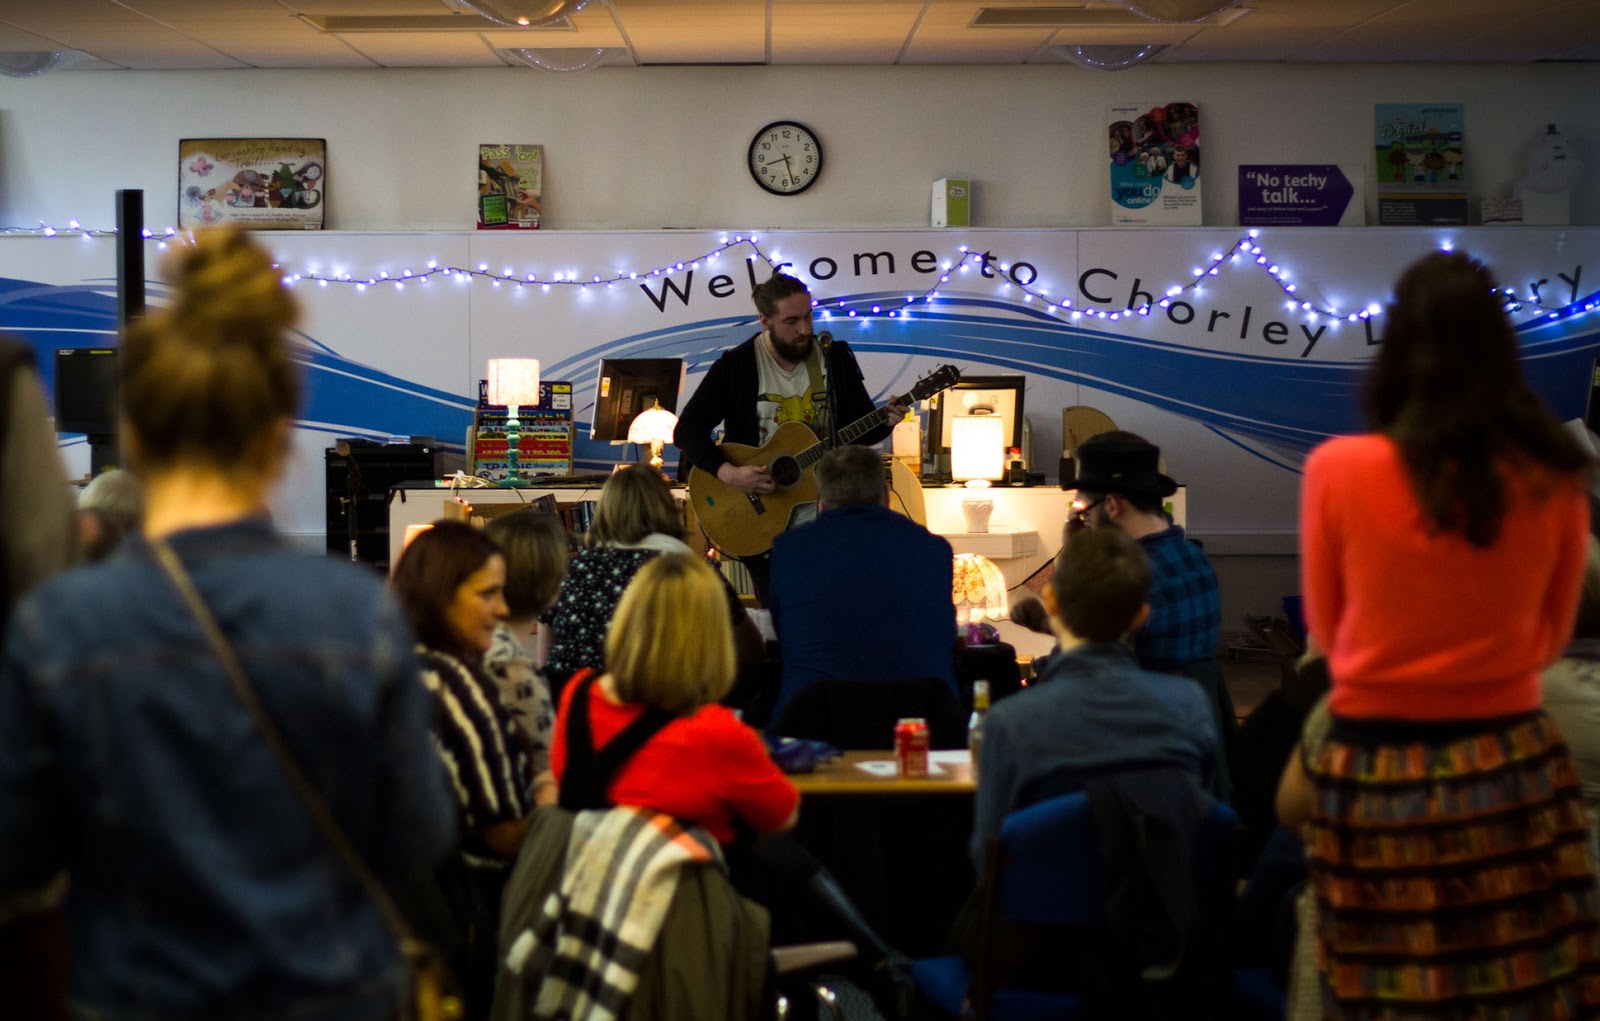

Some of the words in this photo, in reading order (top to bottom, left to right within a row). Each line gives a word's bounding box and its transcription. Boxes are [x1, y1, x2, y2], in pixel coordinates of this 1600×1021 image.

[781, 130, 791, 139] 12
[761, 142, 771, 151] 10
[804, 143, 810, 151] 2
[481, 146, 510, 160] Pass
[758, 154, 765, 162] 9
[806, 155, 812, 163] 3
[761, 166, 768, 175] 8
[770, 175, 776, 183] 7
[782, 179, 788, 187] 6
[794, 176, 800, 184] 5
[1284, 173, 1327, 191] techy
[1143, 184, 1160, 196] do
[1261, 187, 1315, 204] talk...
[981, 250, 1037, 286] to
[1078, 268, 1326, 358] Chorley
